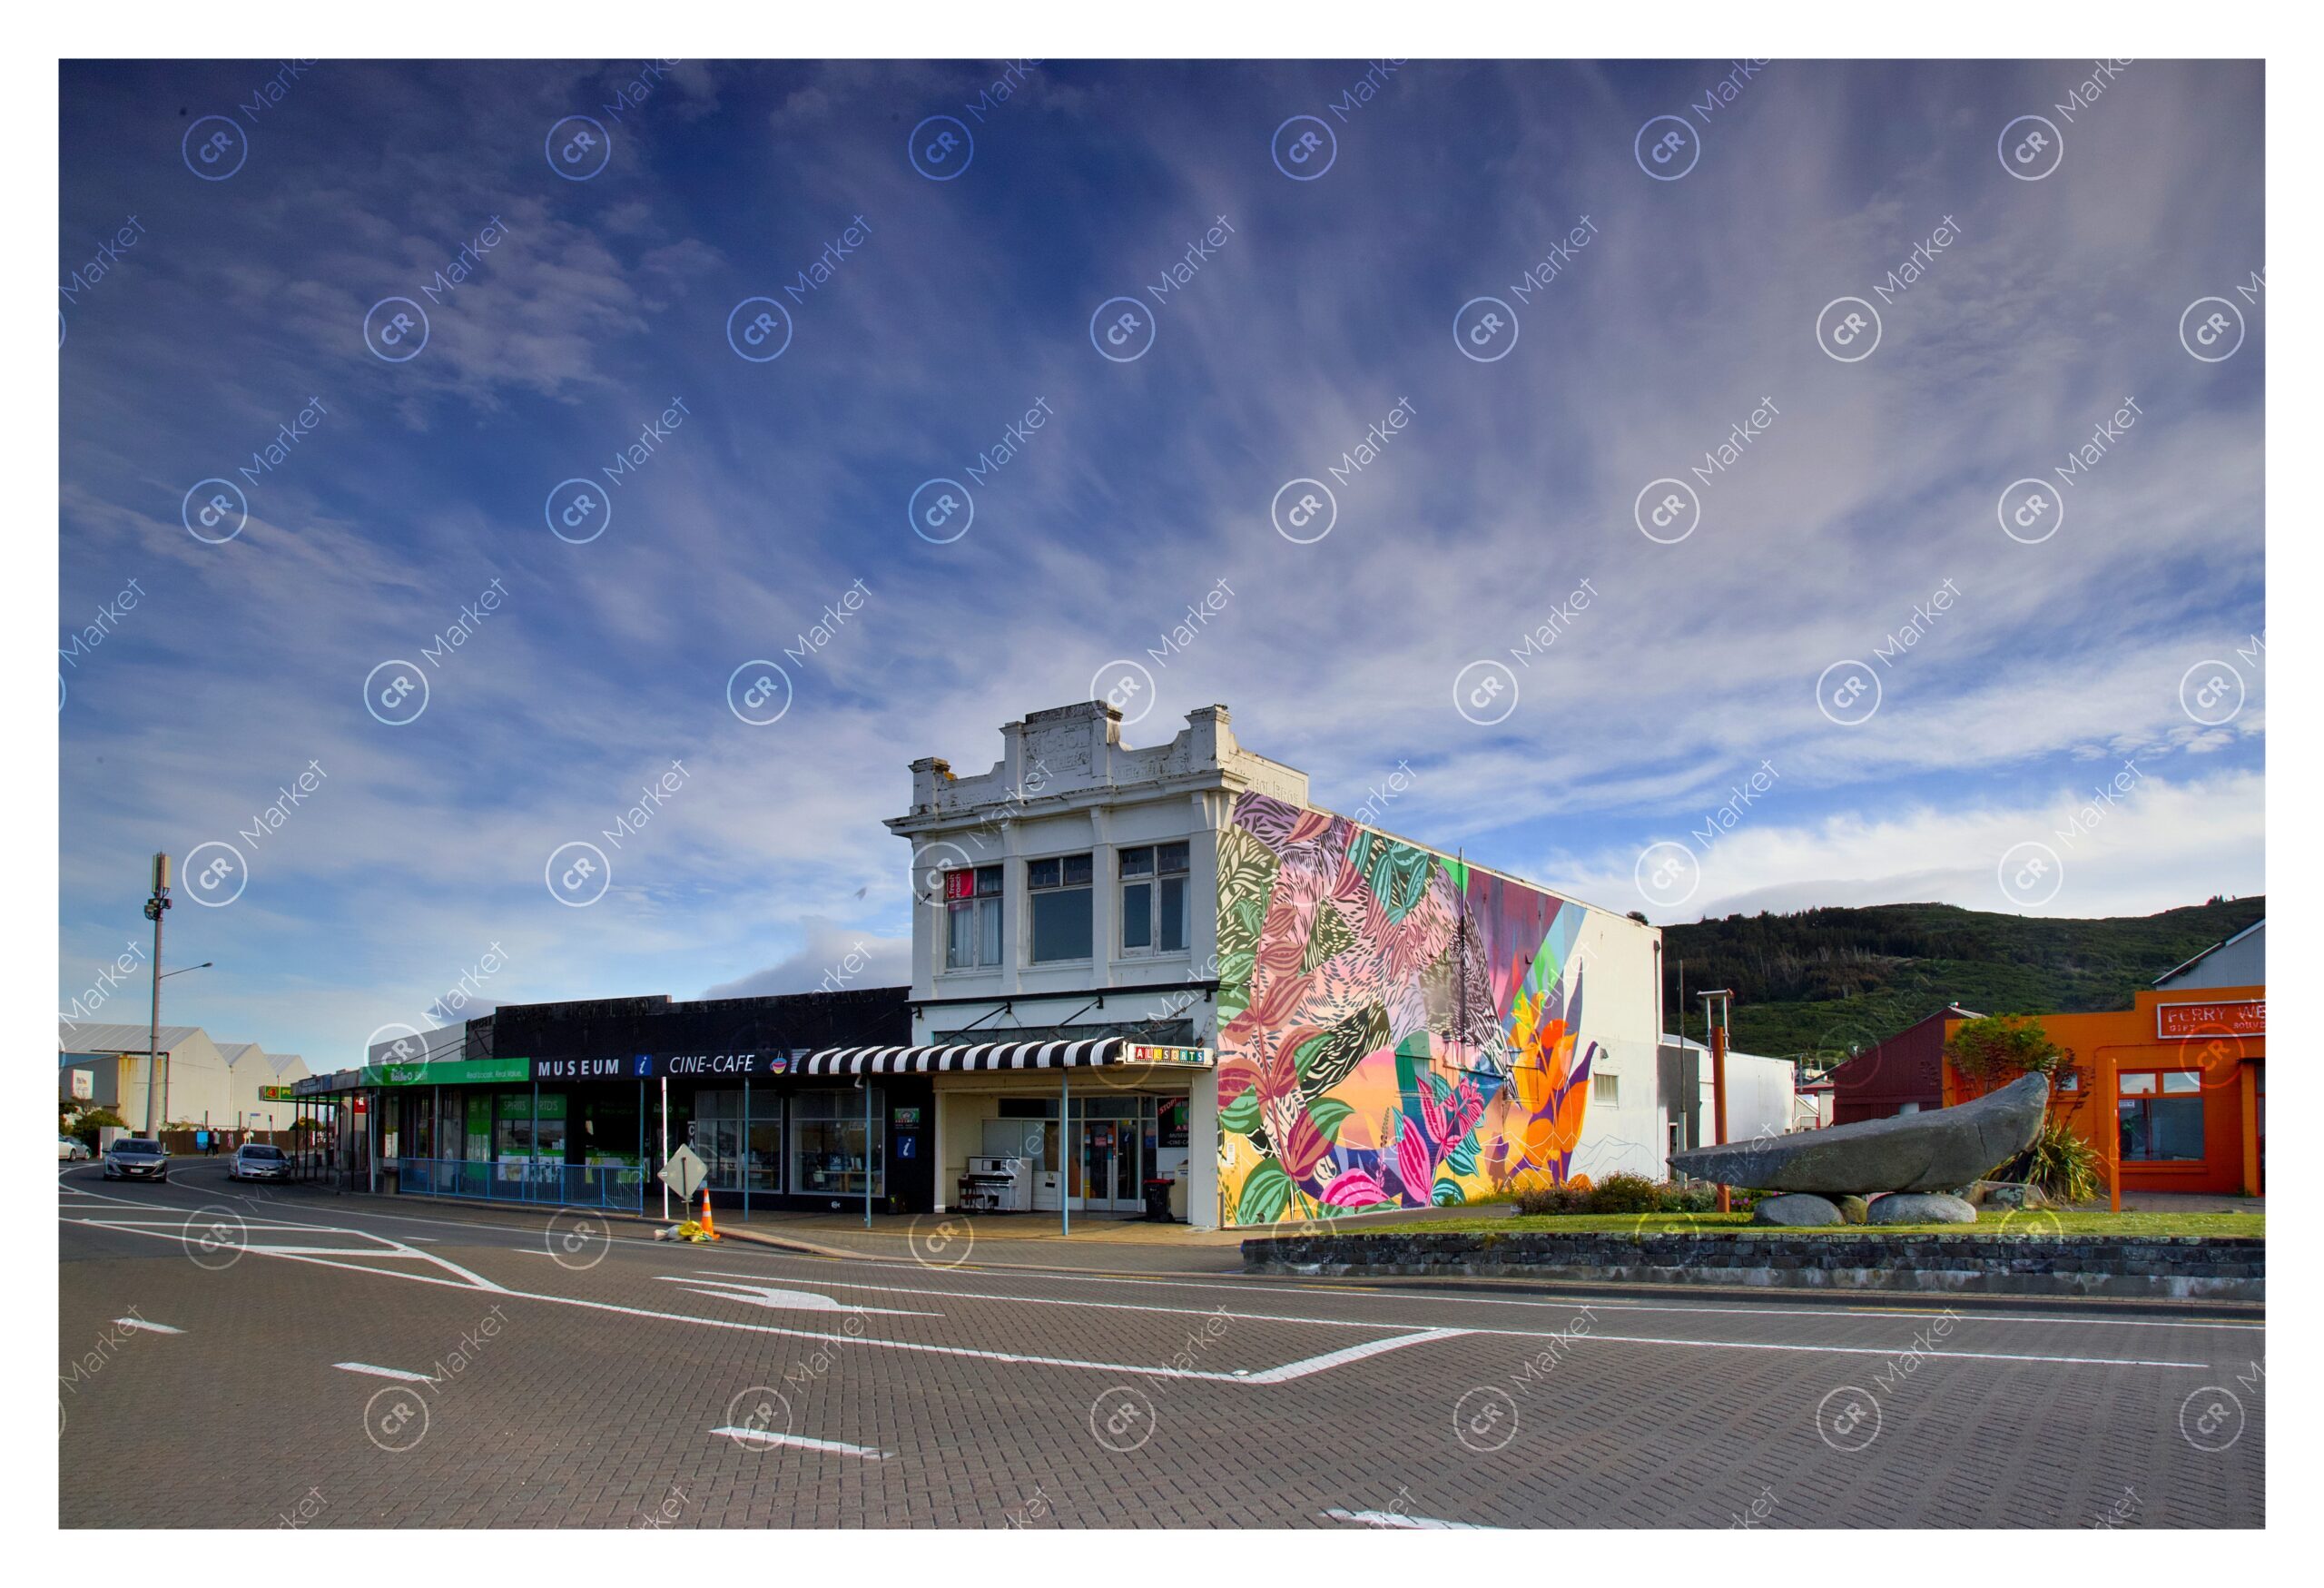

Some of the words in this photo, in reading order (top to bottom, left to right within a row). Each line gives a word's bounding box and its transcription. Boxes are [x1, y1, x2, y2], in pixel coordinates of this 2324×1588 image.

[2168, 1007, 2226, 1022] FERRY
[1137, 1047, 1203, 1061] ALLSORTS
[537, 1059, 619, 1077] MUSEUM
[669, 1054, 755, 1073] CINE-CAFE
[504, 1100, 527, 1111] SPIRITS
[1159, 1098, 1177, 1115] STOP!
